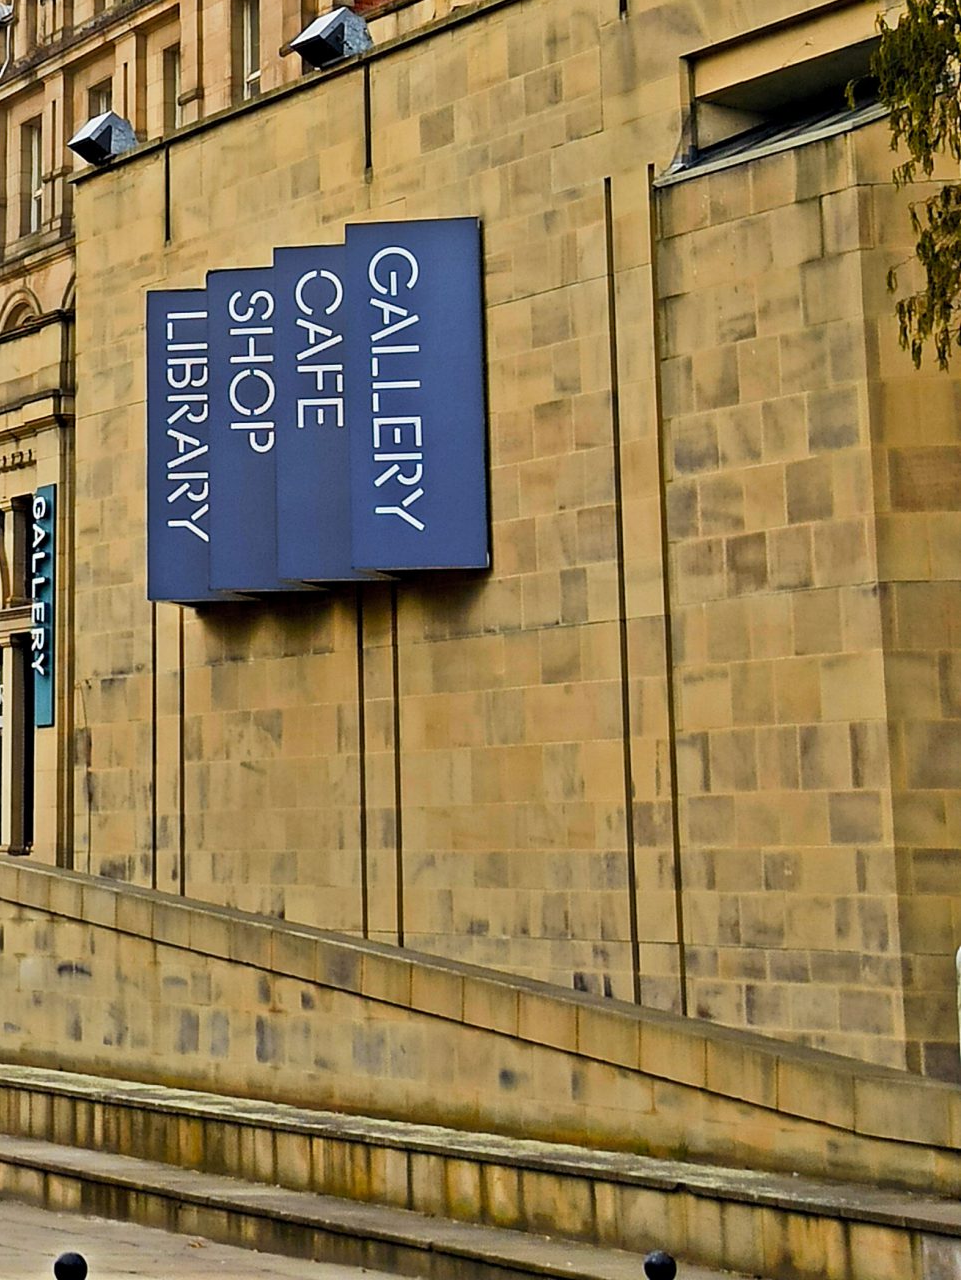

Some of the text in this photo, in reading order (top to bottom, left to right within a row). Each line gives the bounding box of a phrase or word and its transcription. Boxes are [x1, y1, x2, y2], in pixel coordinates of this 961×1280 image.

[167, 311, 210, 542] LIBRARY
[228, 290, 276, 453] SHOP
[295, 269, 344, 429] CAFE
[368, 246, 425, 531] GALLERY
[31, 496, 46, 676] GALLERY
